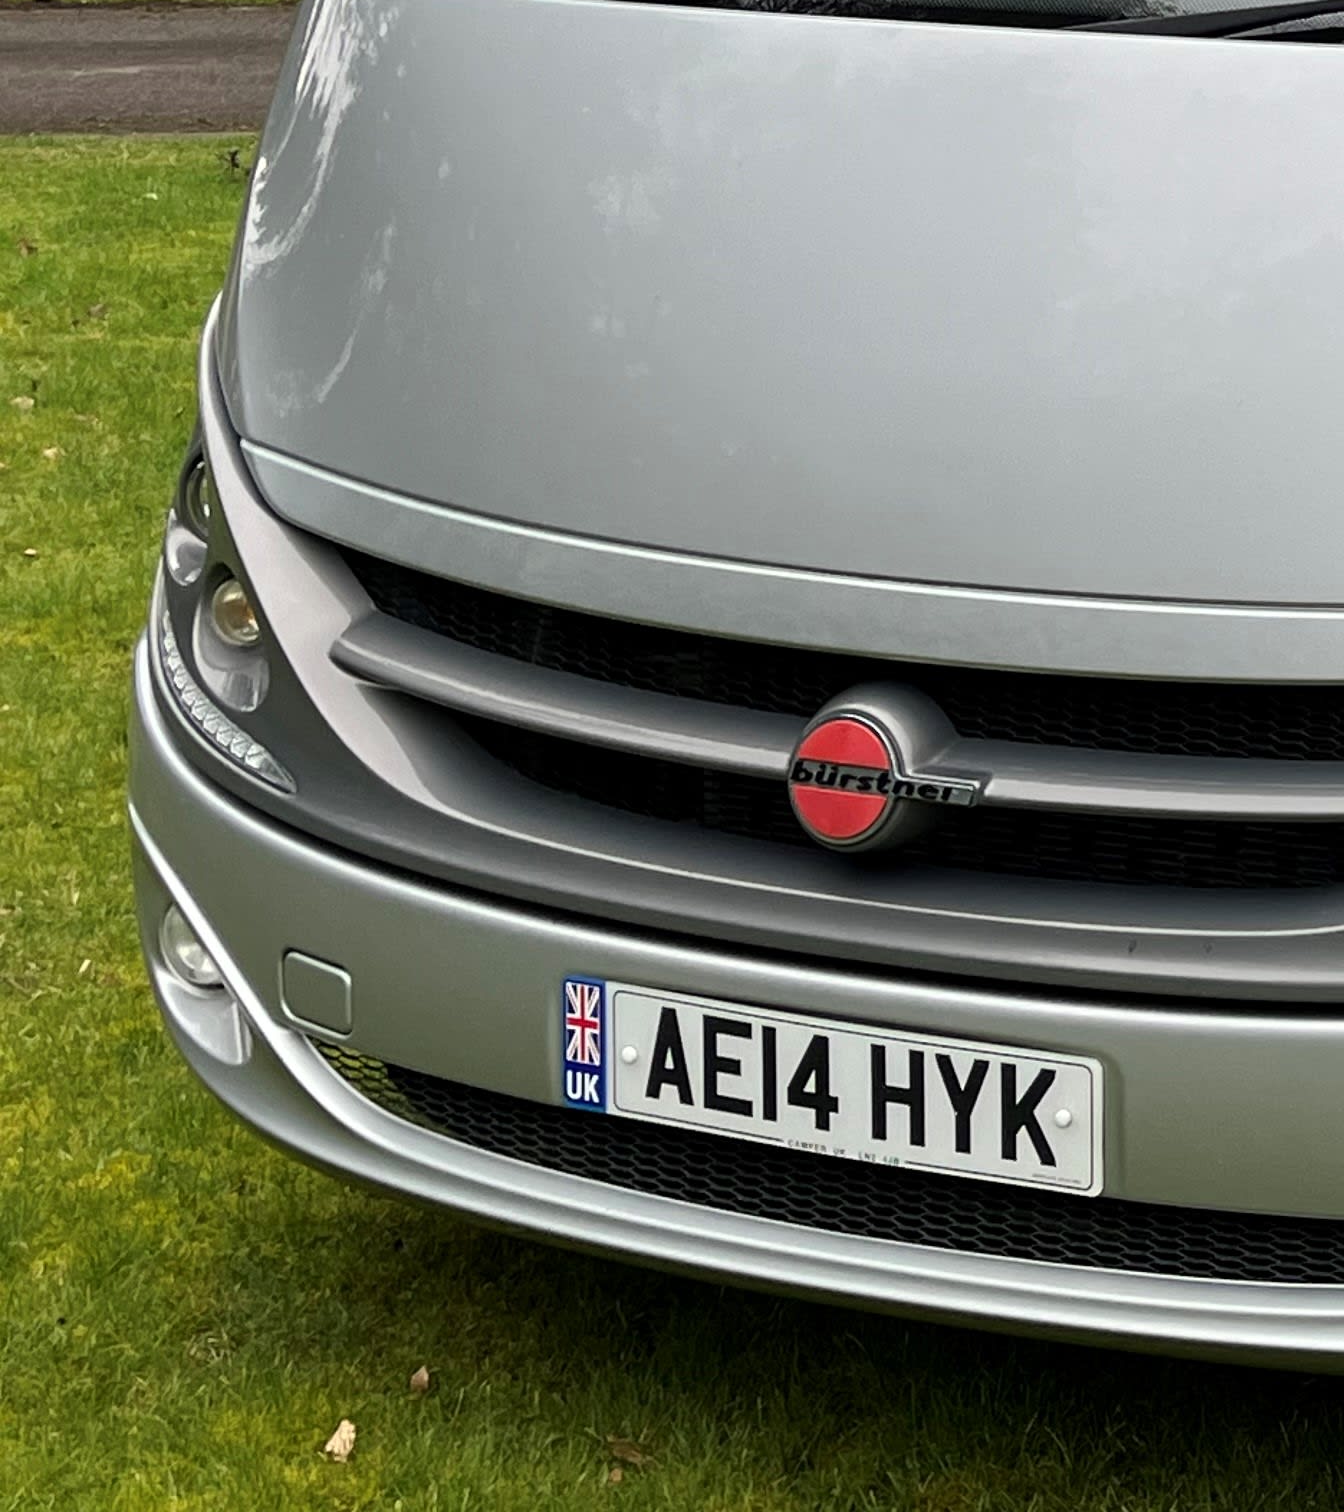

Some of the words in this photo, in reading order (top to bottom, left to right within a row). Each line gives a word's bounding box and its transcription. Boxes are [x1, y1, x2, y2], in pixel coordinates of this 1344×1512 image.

[791, 762, 955, 802] bürstner
[566, 1070, 599, 1104] UK
[645, 1006, 839, 1131] AE14
[870, 1044, 1056, 1168] HYK
